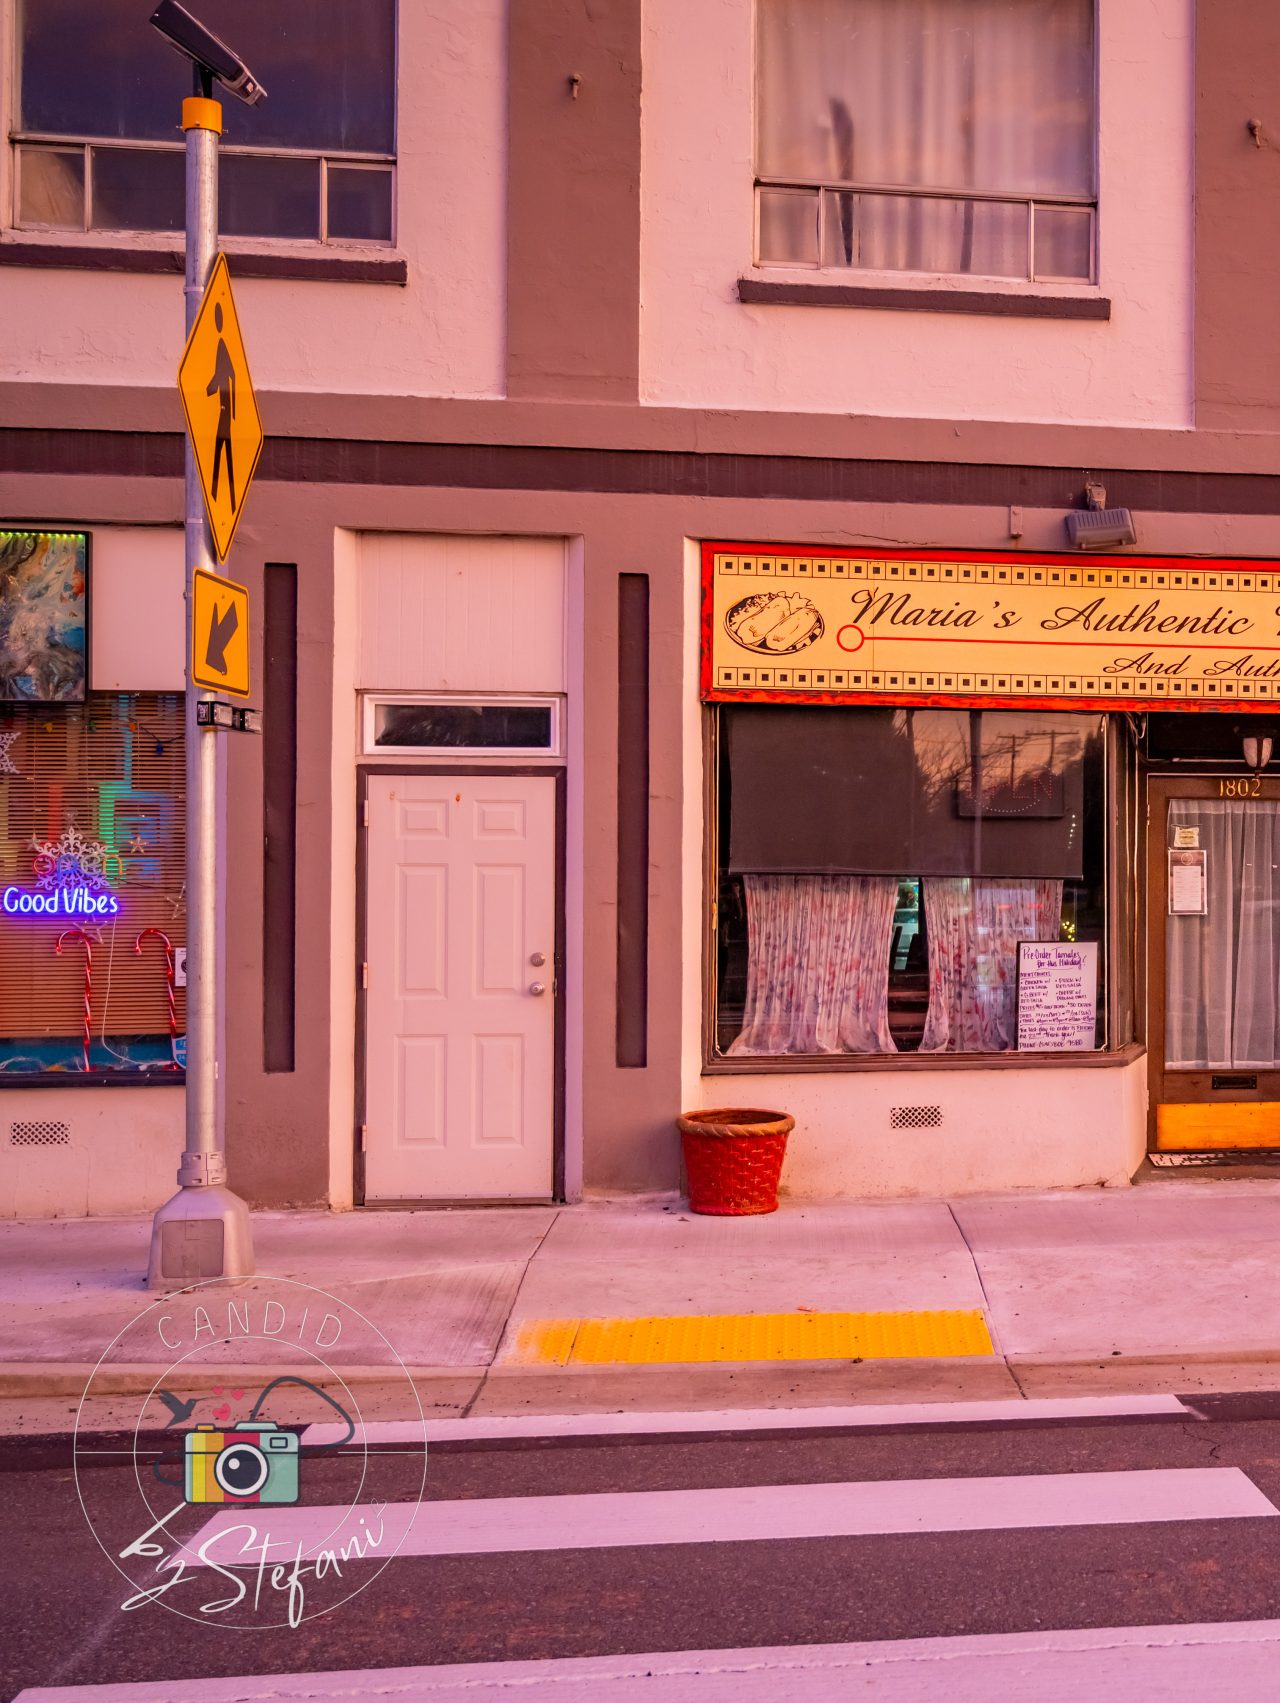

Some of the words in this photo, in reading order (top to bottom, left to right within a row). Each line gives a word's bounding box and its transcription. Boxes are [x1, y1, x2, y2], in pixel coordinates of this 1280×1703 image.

[851, 586, 1022, 629] Maria's
[1040, 597, 1254, 636] Authentic
[1103, 652, 1191, 679] And
[1219, 778, 1262, 797] 1802
[3, 886, 59, 914] Good
[63, 886, 118, 914] Vibes
[1051, 946, 1080, 959] Tamales
